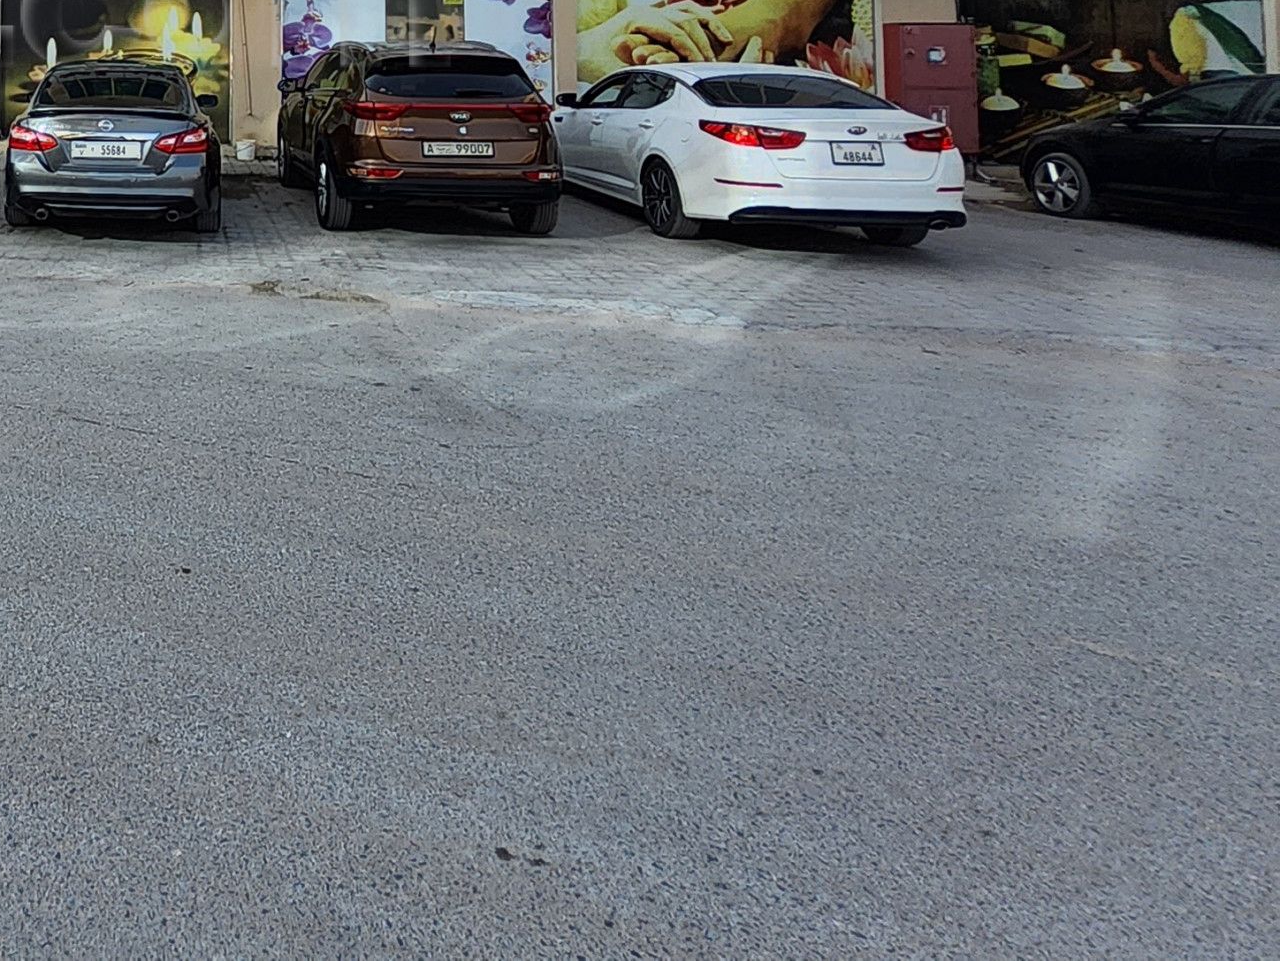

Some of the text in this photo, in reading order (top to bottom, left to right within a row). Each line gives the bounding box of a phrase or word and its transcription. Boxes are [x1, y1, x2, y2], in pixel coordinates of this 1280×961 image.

[100, 145, 126, 156] 55684
[426, 143, 435, 155] A
[455, 142, 491, 155] 99007
